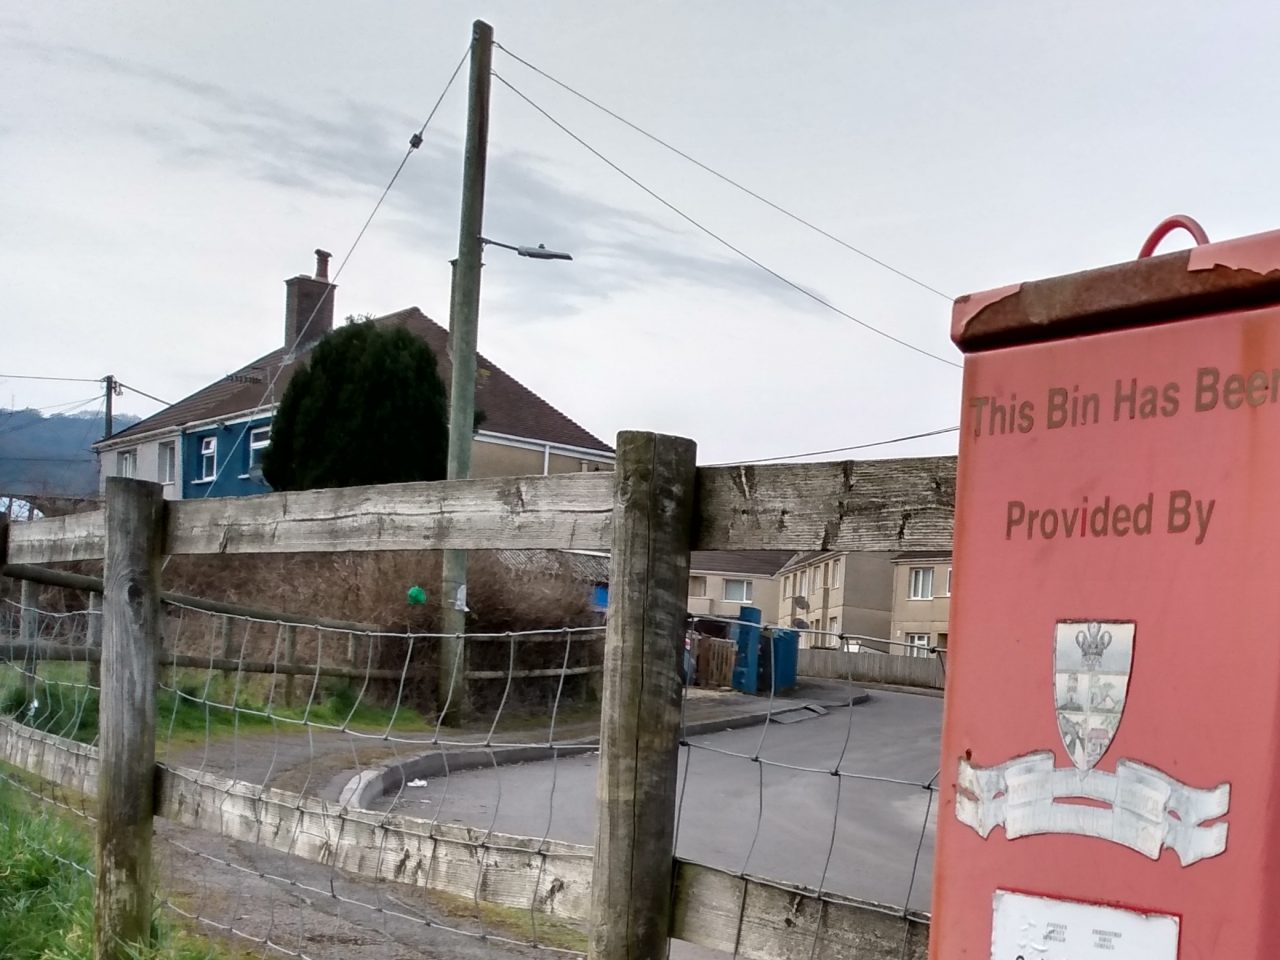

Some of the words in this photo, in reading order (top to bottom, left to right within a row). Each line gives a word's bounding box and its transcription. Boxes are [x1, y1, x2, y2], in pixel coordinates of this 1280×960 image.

[970, 393, 1035, 438] This
[1047, 385, 1100, 429] Bin
[1113, 378, 1180, 421] Has
[1005, 492, 1154, 540] Provided
[1167, 489, 1216, 545] By
